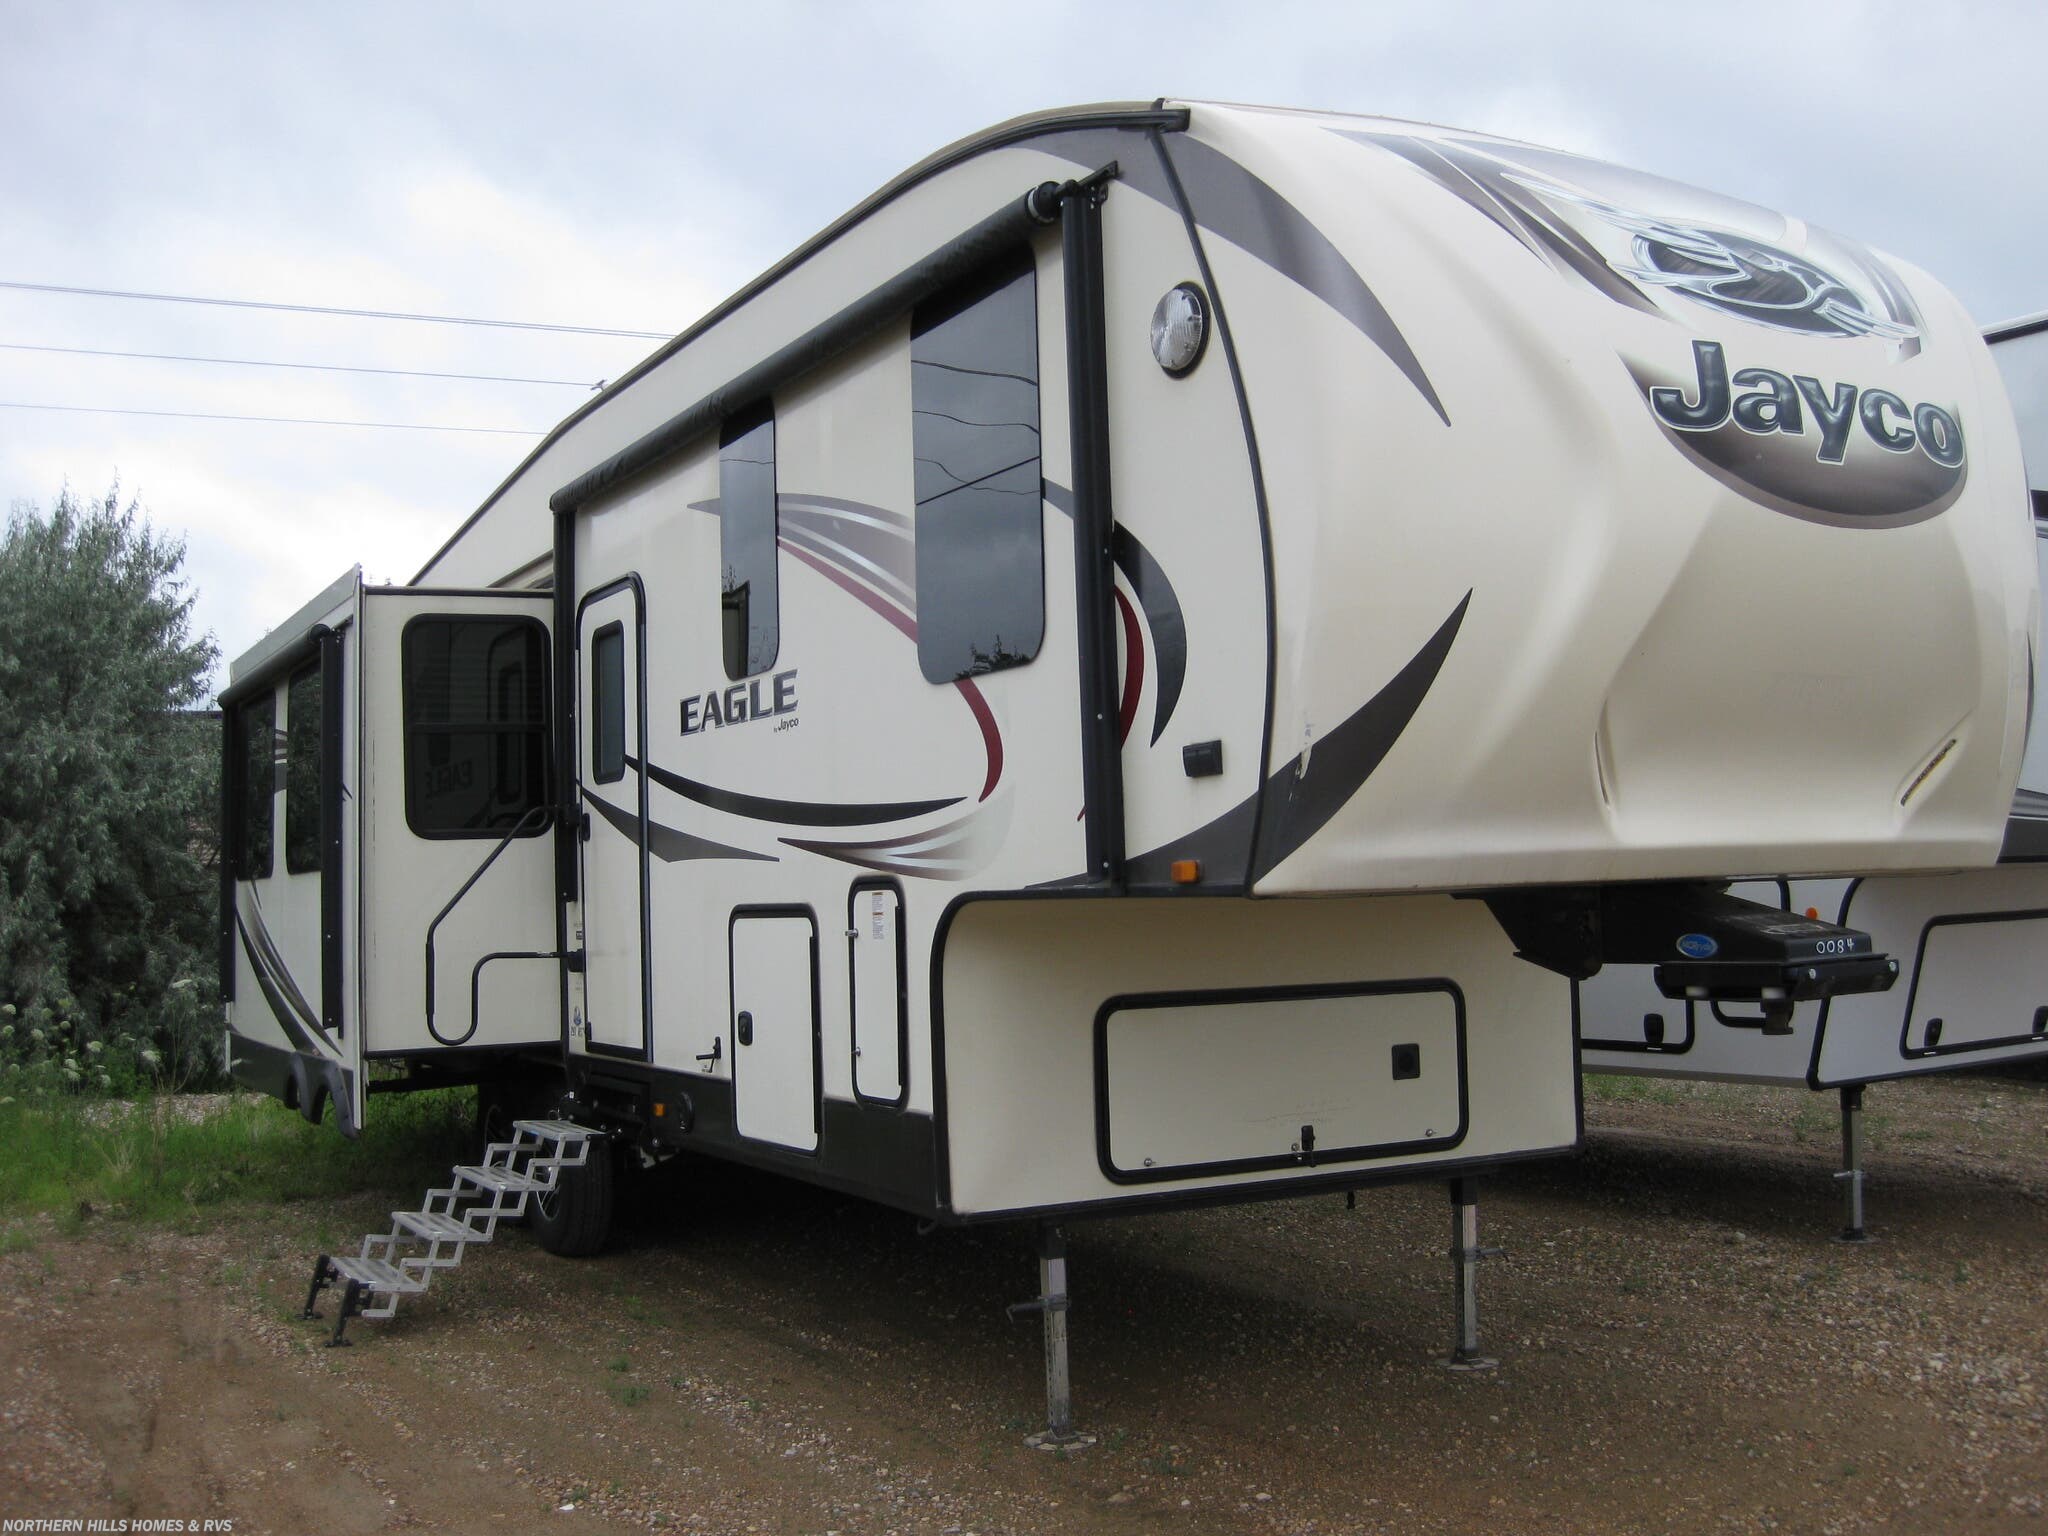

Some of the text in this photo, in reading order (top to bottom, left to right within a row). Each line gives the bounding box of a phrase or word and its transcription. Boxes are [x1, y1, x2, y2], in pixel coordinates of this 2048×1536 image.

[1649, 339, 1966, 468] Jayco
[680, 669, 799, 737] EAGLE
[778, 718, 799, 732] Jayco
[1815, 937, 1855, 954] 0084
